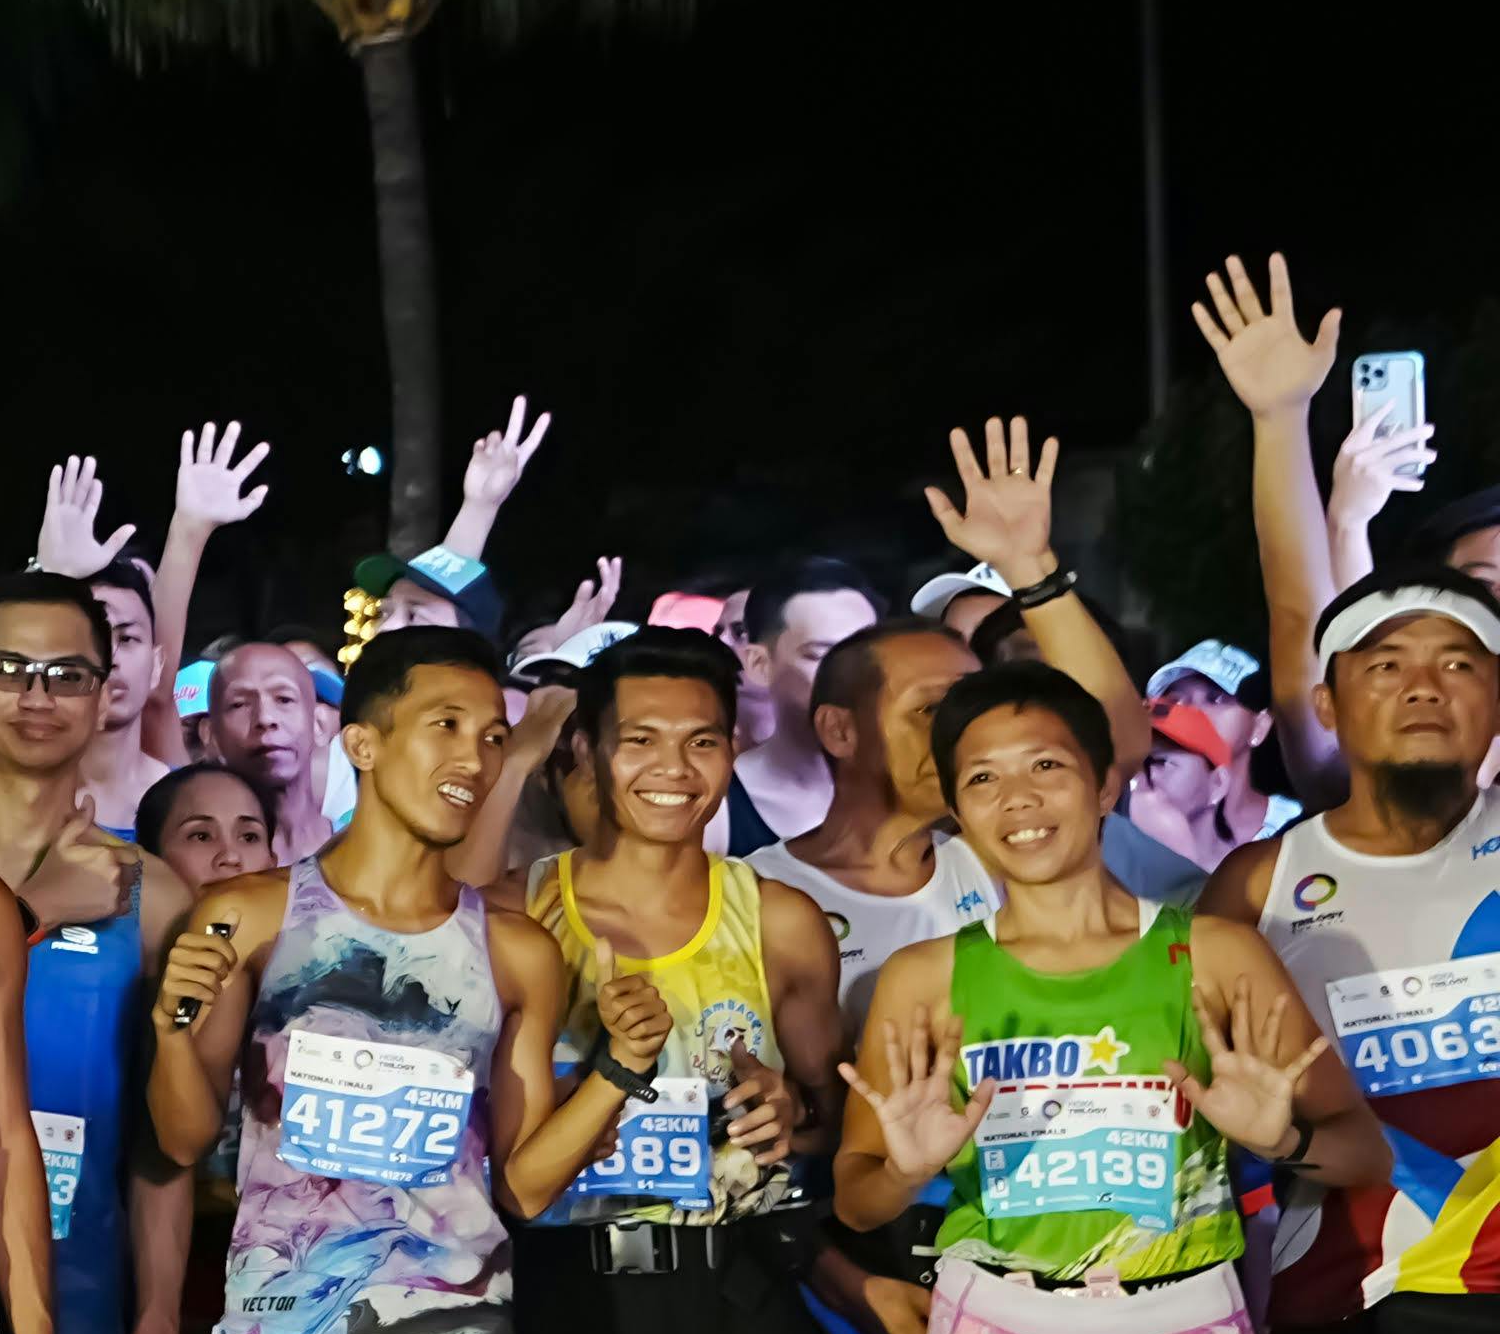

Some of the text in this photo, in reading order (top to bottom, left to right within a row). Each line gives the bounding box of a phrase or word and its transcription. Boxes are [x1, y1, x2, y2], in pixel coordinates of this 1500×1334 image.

[1355, 1017, 1500, 1072] 4063
[965, 1041, 1080, 1086] TAKBO
[290, 1070, 335, 1085] NATIONAL
[404, 1089, 463, 1110] 42KM
[286, 1093, 460, 1155] 41272
[641, 1118, 700, 1132] 42KM
[1106, 1130, 1167, 1149] 42KM
[1015, 1150, 1167, 1189] 42139
[243, 1296, 297, 1313] VECTOR
